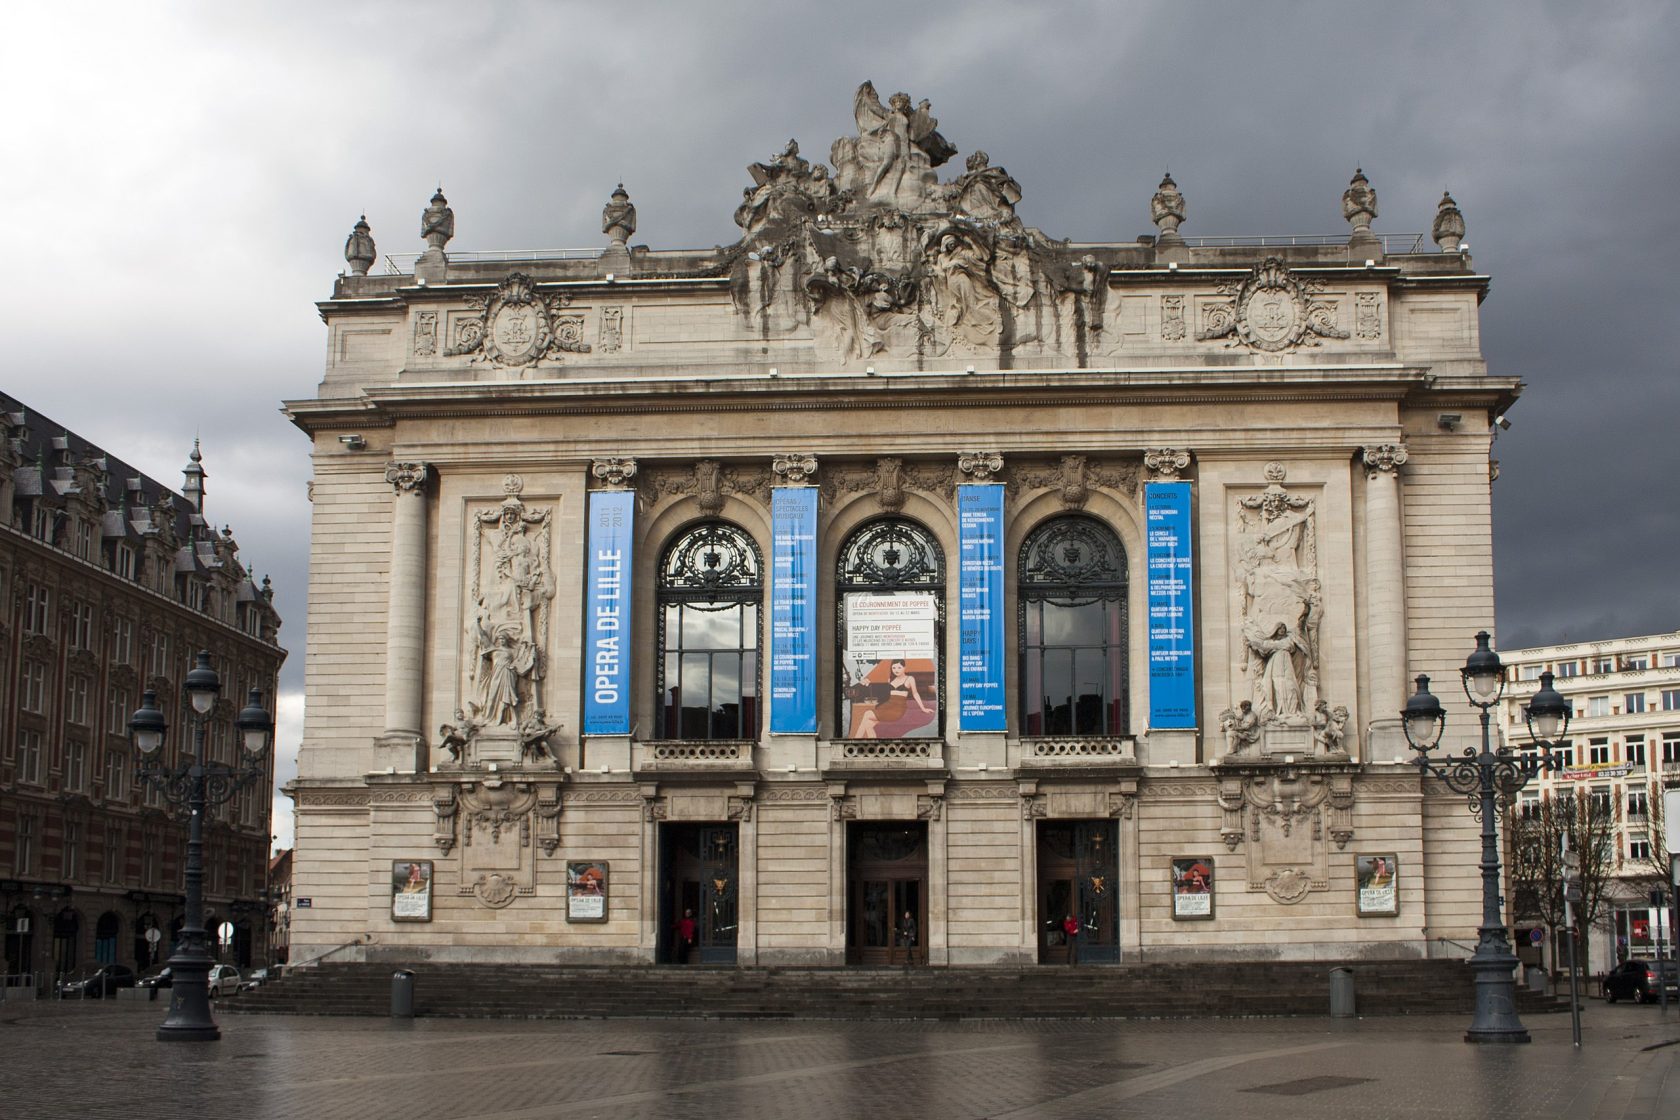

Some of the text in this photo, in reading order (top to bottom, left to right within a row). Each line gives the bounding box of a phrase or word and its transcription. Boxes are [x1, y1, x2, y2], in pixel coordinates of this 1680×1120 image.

[601, 507, 610, 527] 2011
[613, 507, 623, 527] 2012
[598, 549, 621, 600] LILLE
[597, 606, 620, 630] DE
[595, 636, 619, 704] OPERA
